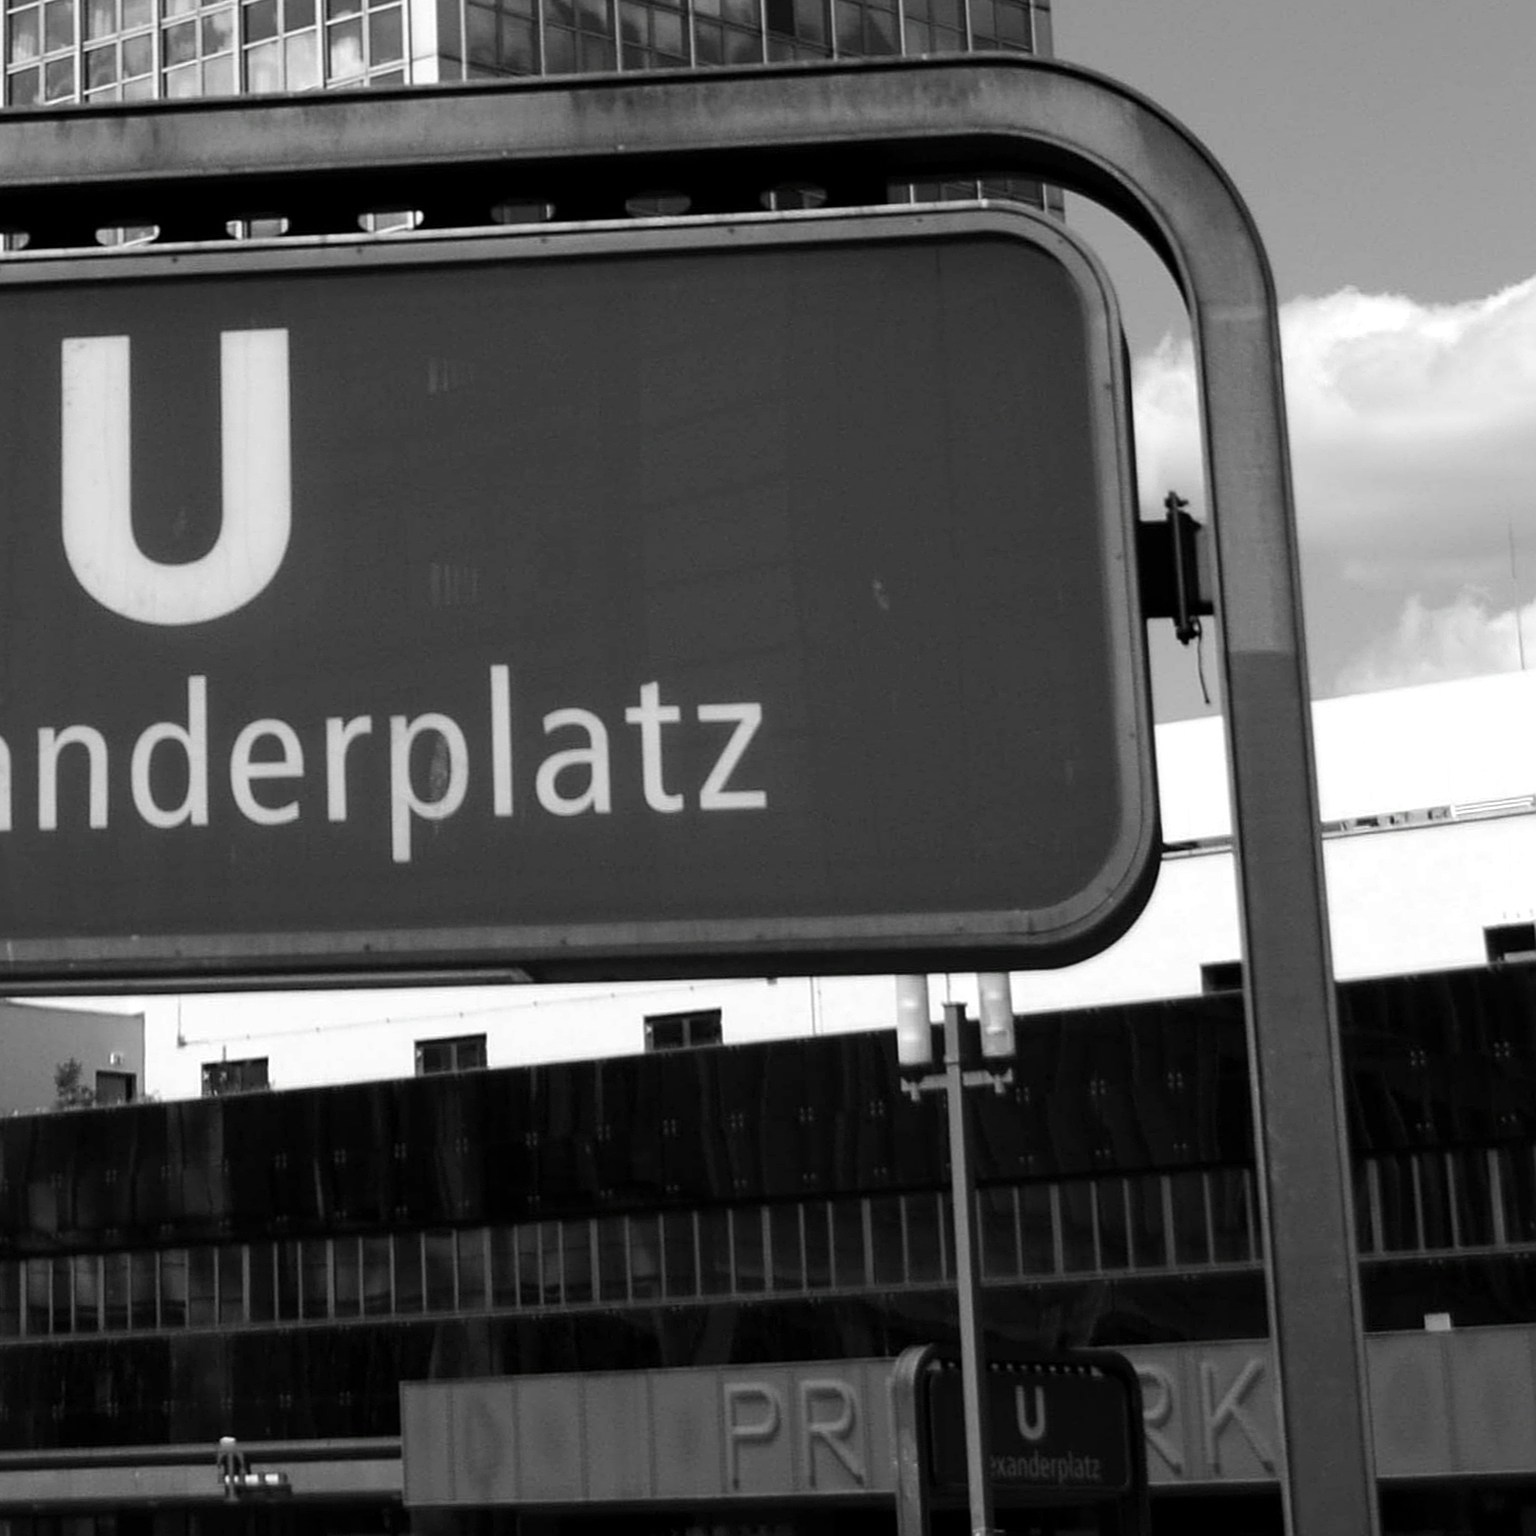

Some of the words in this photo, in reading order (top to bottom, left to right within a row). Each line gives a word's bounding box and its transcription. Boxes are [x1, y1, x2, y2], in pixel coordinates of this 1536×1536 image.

[61, 328, 293, 627] U
[1015, 1385, 1047, 1441] U
[990, 1449, 1103, 1483] xanderplatz
